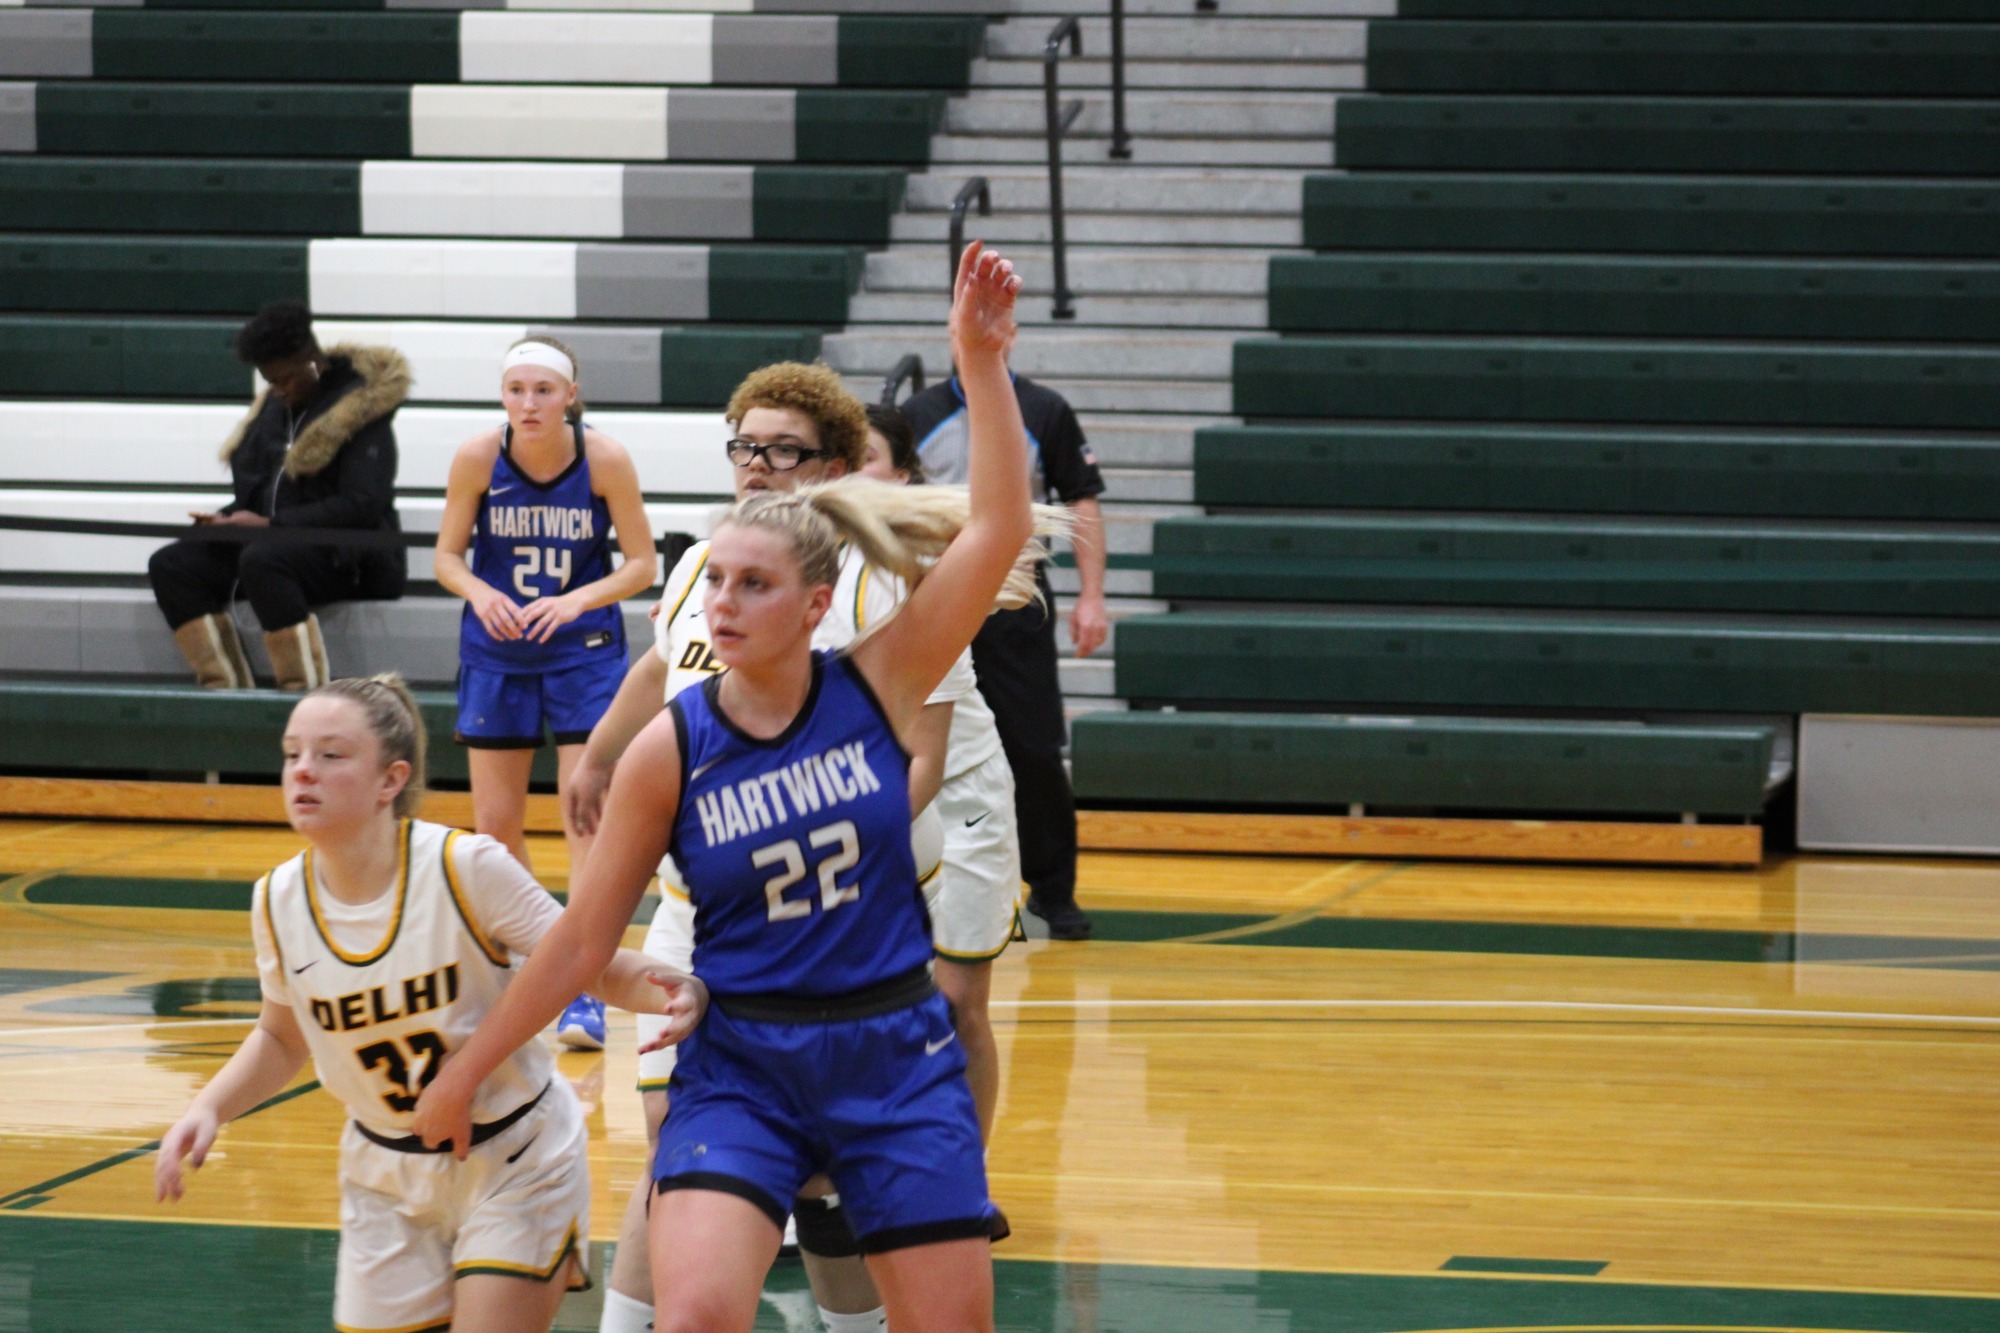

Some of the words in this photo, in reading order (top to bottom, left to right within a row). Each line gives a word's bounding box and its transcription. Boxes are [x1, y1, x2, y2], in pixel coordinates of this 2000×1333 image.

[489, 506, 594, 541] HARTWICK
[513, 546, 572, 597] 24
[677, 639, 729, 673] DE
[696, 741, 881, 847] HARTWICK
[752, 820, 861, 922] 22
[309, 962, 459, 1033] DELHI
